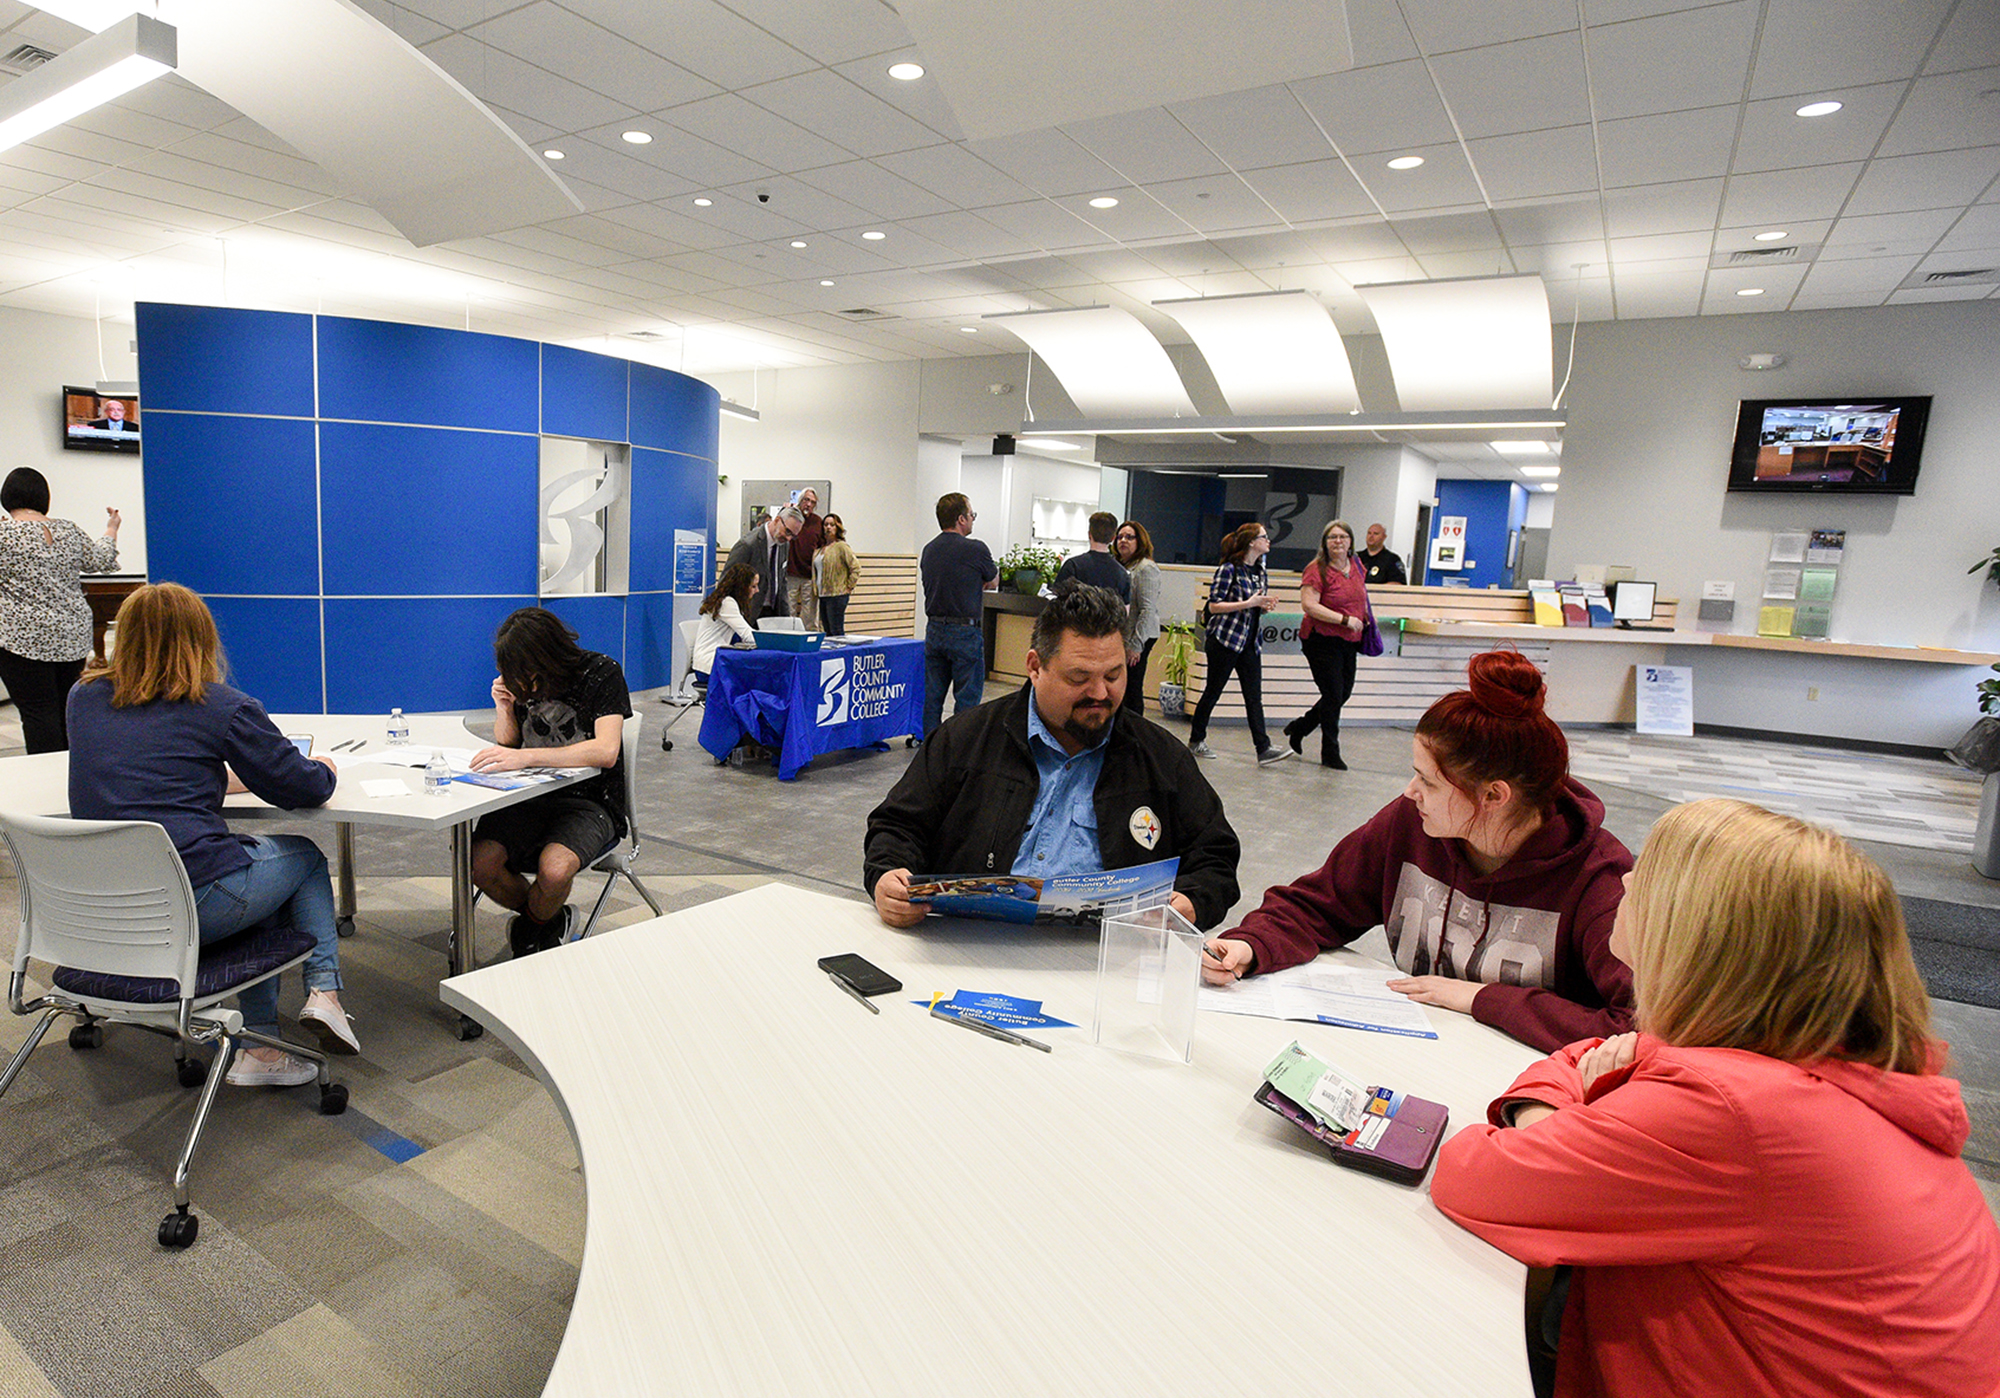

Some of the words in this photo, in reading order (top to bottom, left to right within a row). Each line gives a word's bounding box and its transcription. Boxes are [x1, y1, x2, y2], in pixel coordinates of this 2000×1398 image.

[853, 653, 885, 672] BUTLER
[852, 669, 891, 687] COUNTY
[851, 683, 906, 704] COMMUNITY
[850, 700, 889, 720] COLLEGE
[1107, 876, 1140, 885] College
[944, 1004, 983, 1014] College
[958, 1011, 995, 1020] County
[986, 1010, 1046, 1023] Community
[998, 1017, 1028, 1026] Butler
